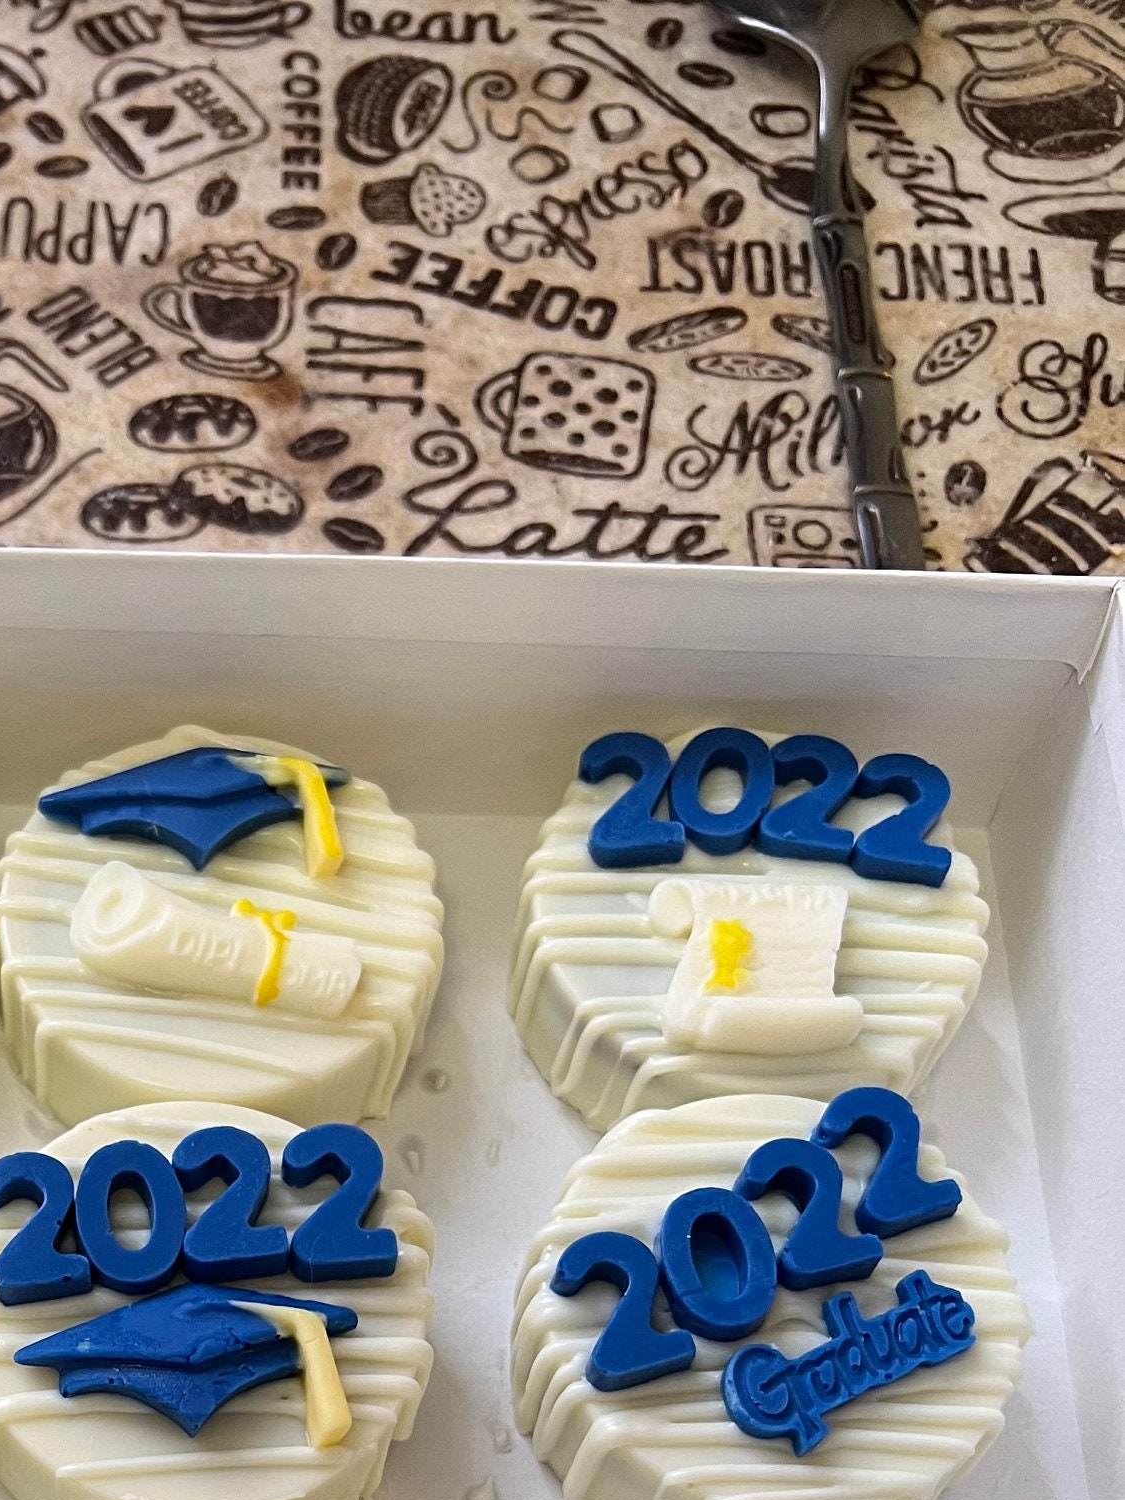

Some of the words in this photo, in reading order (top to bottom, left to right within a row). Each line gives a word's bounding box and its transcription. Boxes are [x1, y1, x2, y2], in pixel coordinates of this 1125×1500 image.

[333, 0, 517, 44] bean
[280, 52, 322, 191] COFFEE
[370, 240, 618, 341] COFFEE
[639, 235, 814, 300] ROAST
[876, 240, 1047, 308] FRENC
[25, 286, 161, 390] BLEND
[578, 726, 954, 889] 2022
[549, 1086, 965, 1394] 2022
[720, 1268, 978, 1458] Graduate
